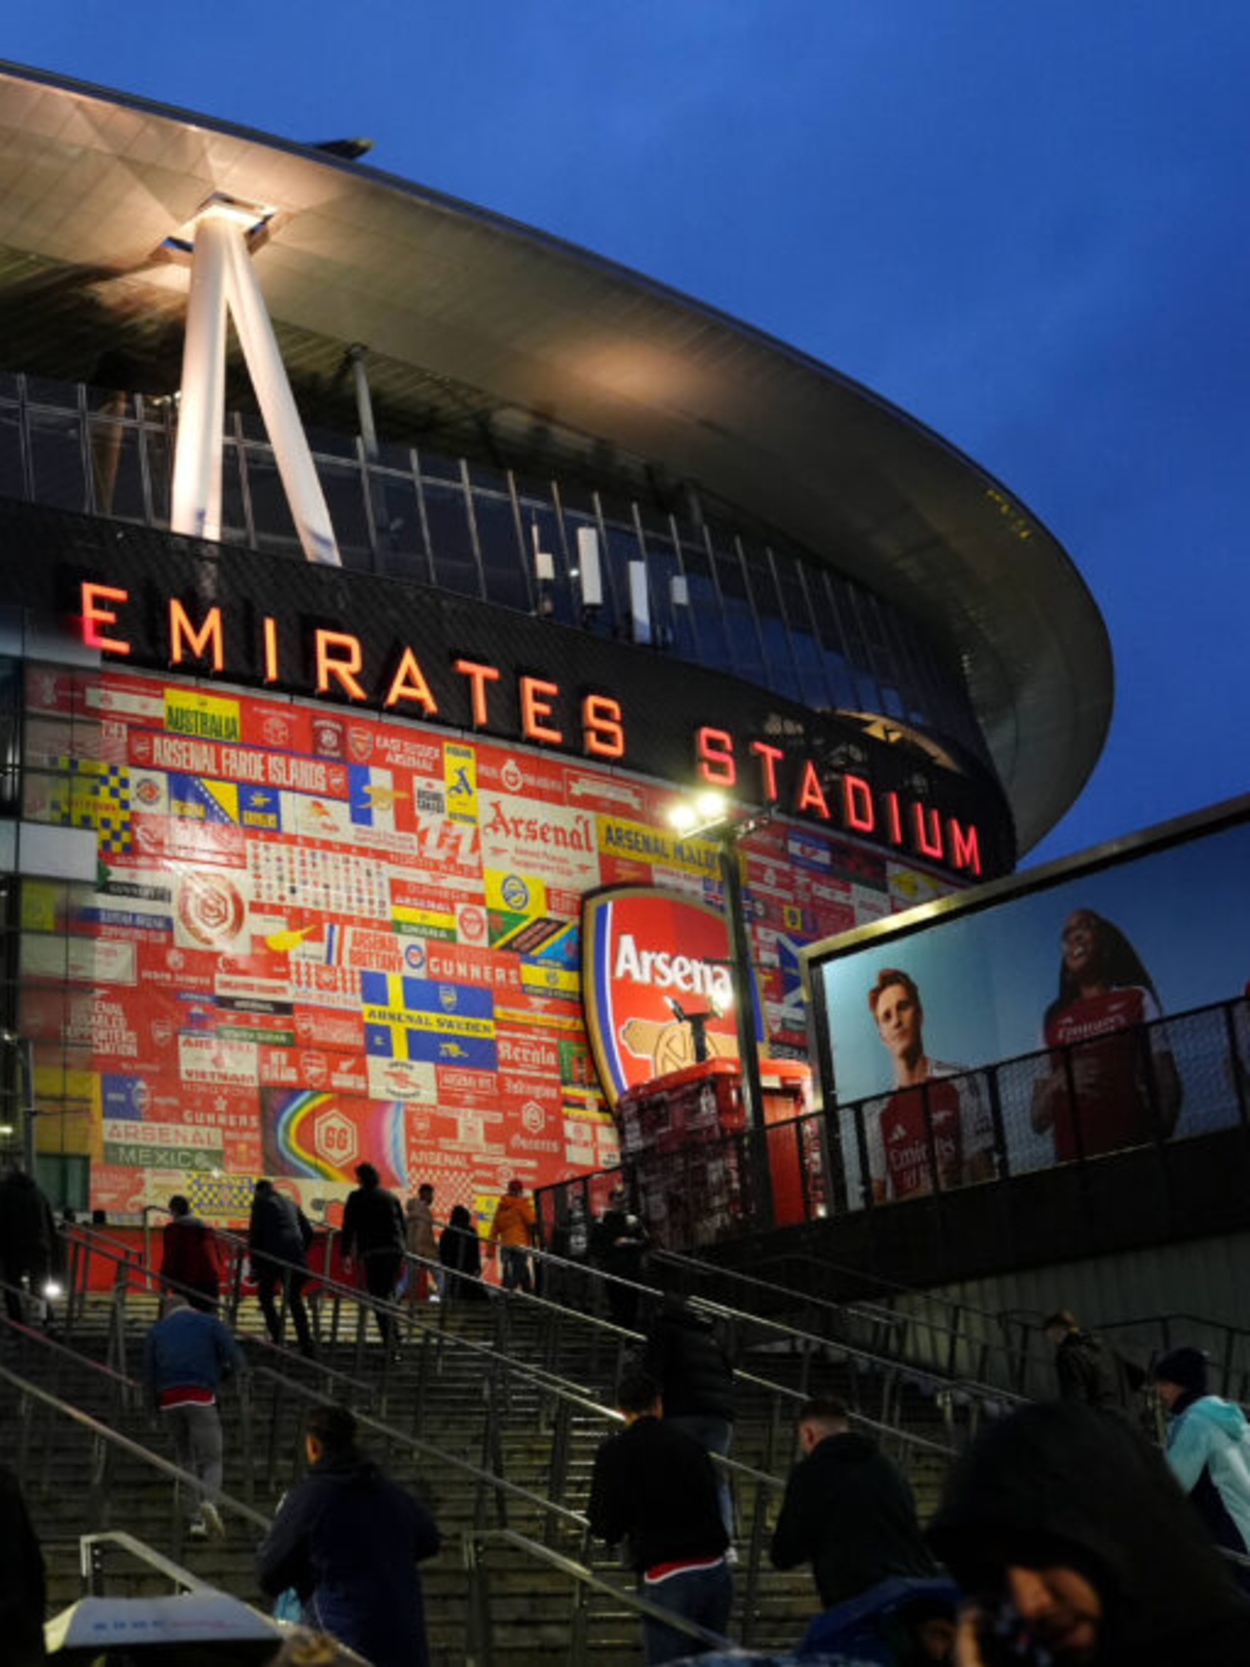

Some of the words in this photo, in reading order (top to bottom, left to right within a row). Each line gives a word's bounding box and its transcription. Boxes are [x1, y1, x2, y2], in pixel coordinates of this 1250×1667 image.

[81, 582, 623, 757] EMIRATES
[697, 727, 981, 875] STADIUM
[167, 705, 237, 740] AUSTRALIA
[153, 737, 218, 774] ARSENAL
[221, 748, 266, 781] FAROE
[268, 755, 327, 791] ISLANDS
[483, 800, 594, 853] Arsenal
[606, 825, 669, 859] ARSENAL
[428, 961, 519, 985] GUNNERS
[615, 934, 734, 998] Arsena
[367, 1010, 433, 1027] ARSENAL
[436, 1018, 492, 1034] SWEDEN
[498, 1039, 556, 1067] Kerala
[185, 1069, 254, 1084] VIETNAM
[183, 1111, 259, 1128] GUNNERS
[107, 1124, 217, 1145] ARSENAL
[410, 1151, 468, 1168] ARSENAL
